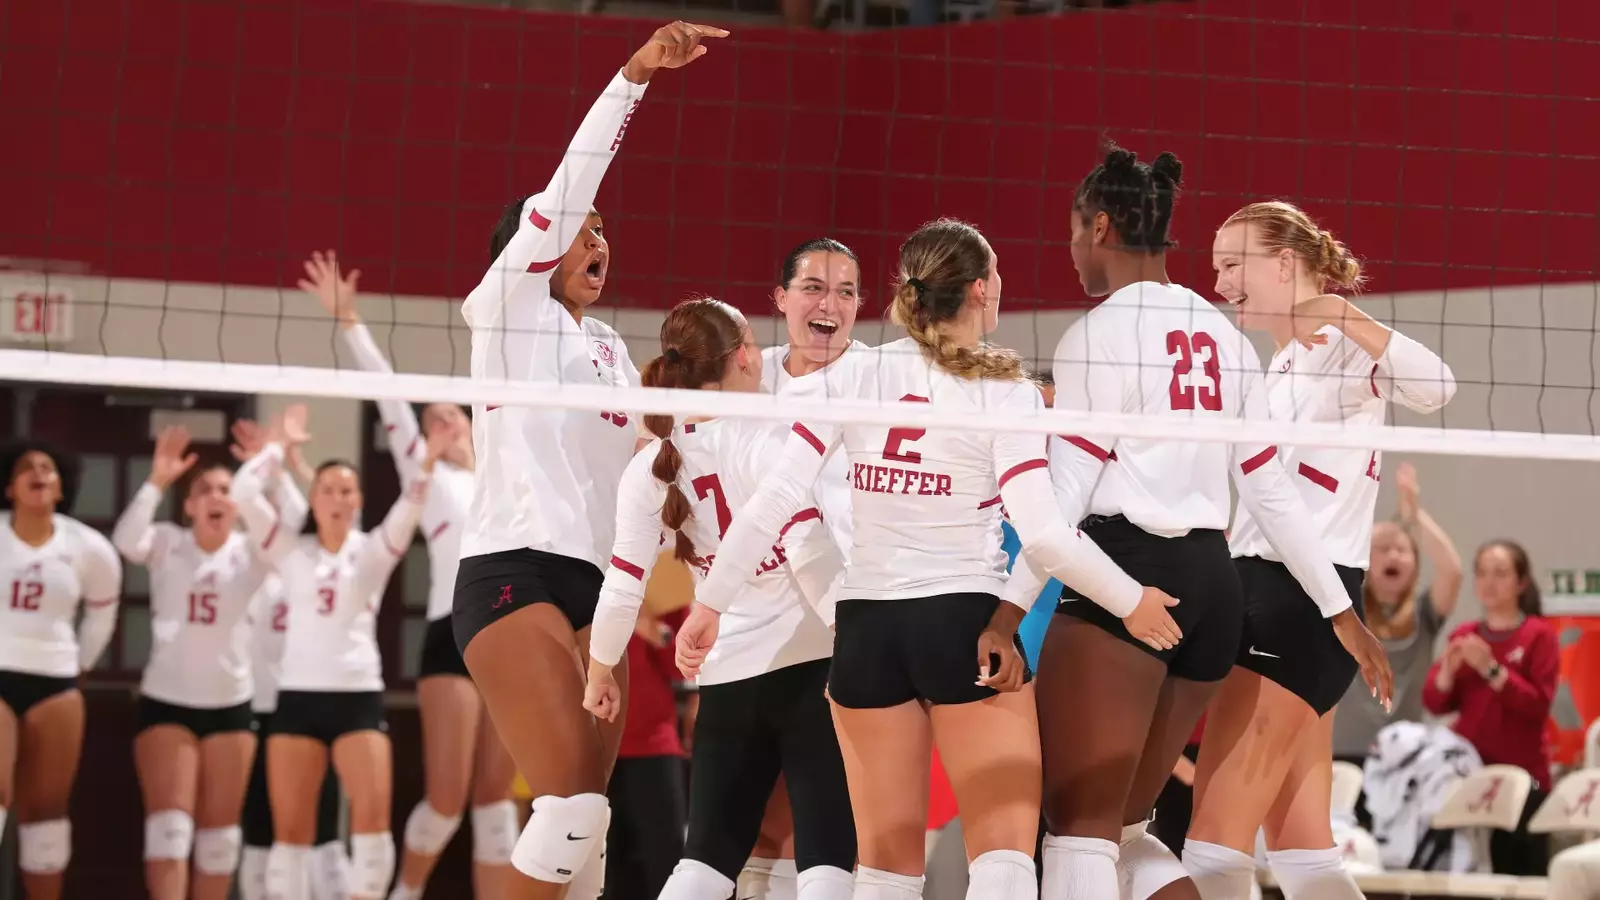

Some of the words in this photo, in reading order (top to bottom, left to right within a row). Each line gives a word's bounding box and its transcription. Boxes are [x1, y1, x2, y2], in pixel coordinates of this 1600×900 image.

[14, 293, 65, 334] EXIT
[1166, 330, 1223, 411] 23
[882, 393, 930, 464] 2
[854, 462, 952, 496] KIEFFER
[691, 473, 732, 541] 7
[10, 580, 44, 610] 12
[188, 593, 218, 624] 15
[317, 588, 334, 615] 3
